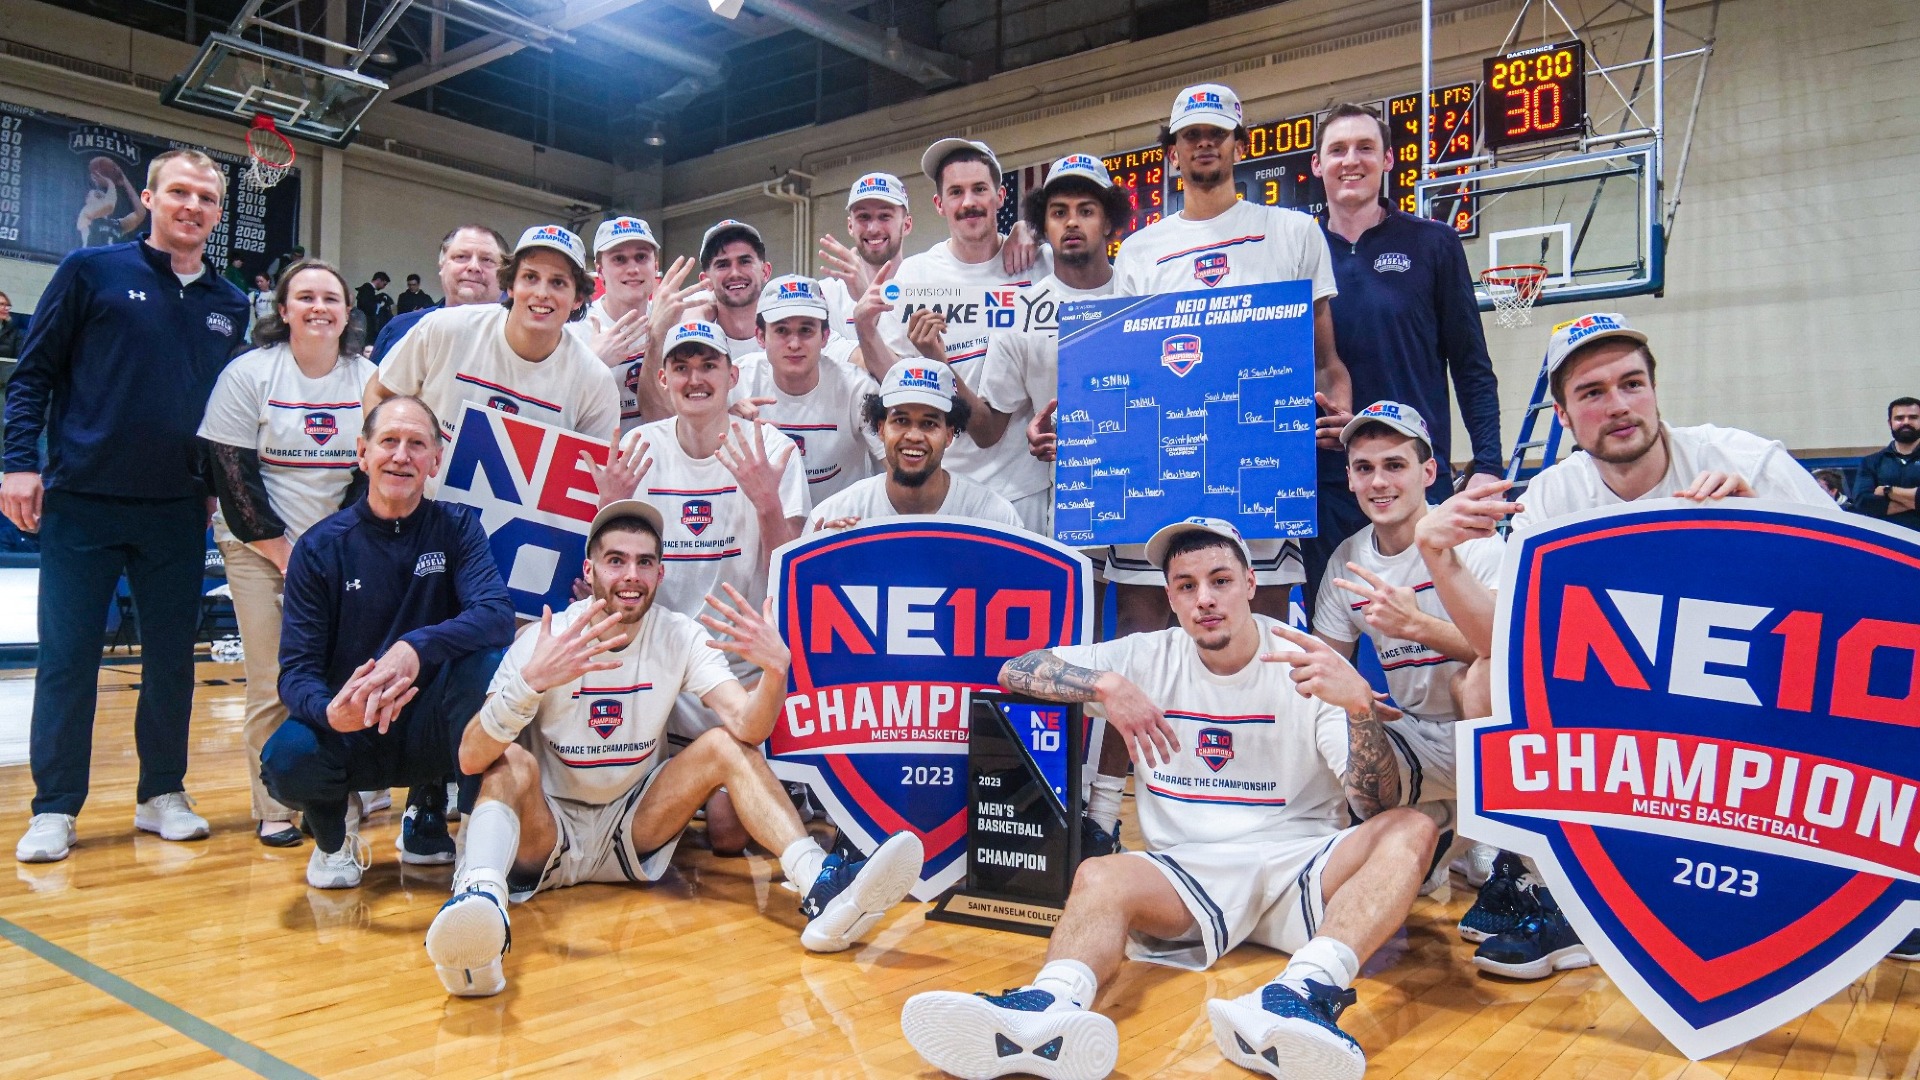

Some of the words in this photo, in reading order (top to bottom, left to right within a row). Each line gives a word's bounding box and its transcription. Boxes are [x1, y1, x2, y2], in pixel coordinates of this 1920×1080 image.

[1506, 44, 1553, 59] DAKTRONICS
[1492, 50, 1572, 90] 20:00
[1188, 92, 1220, 104] NE10
[1392, 97, 1416, 115] PLY
[1444, 86, 1471, 105] PTS
[1505, 82, 1560, 135] 30
[1406, 119, 1418, 135] 4
[1243, 118, 1311, 159] 0:00
[73, 134, 136, 160] ANSELM
[1400, 143, 1418, 161] 10
[1450, 134, 1470, 153] 19
[1063, 155, 1092, 167] NE10
[1126, 153, 1139, 168] FL
[1141, 149, 1163, 165] PTS
[1255, 166, 1286, 181] PERIOD
[1400, 168, 1418, 187] 12
[860, 177, 887, 188] NE10
[237, 191, 267, 206] 2018
[1265, 180, 1278, 205] 3
[236, 202, 267, 218] 2019
[1400, 194, 1417, 213] 15
[235, 225, 267, 241] 2020
[613, 220, 642, 230] NE10
[538, 226, 570, 242] NE10
[234, 237, 266, 254] 2022
[780, 281, 809, 294] NE10
[905, 287, 951, 298] DIVISION
[984, 291, 1016, 307] NE
[1175, 297, 1206, 314] NE10
[1209, 293, 1253, 311] MEN'S
[986, 309, 1015, 328] 10
[1122, 314, 1202, 333] BASKETBALL
[1204, 302, 1308, 327] CHAMPIONSHIP
[1568, 315, 1614, 335] NE10
[679, 322, 711, 334] NE10
[1567, 323, 1621, 346] CHAMPIONS
[945, 339, 974, 353] MBRACE
[1168, 342, 1197, 351] NE10
[904, 367, 938, 382] NE10
[1268, 365, 1293, 376] Anselm
[898, 379, 941, 391] CHAMPIONS
[1101, 373, 1130, 387] SNHU
[1129, 395, 1156, 408] SNHU
[1244, 411, 1263, 424] Pace
[1363, 404, 1401, 417] NE10
[1097, 419, 1121, 434] FPU
[265, 446, 302, 457] EMBRACE
[304, 449, 318, 457] THE
[1097, 511, 1121, 521] SCSU
[680, 540, 694, 548] THE
[1070, 531, 1095, 541] SCSU
[810, 584, 1051, 657] NE10
[1552, 584, 1920, 729] NE10
[593, 705, 619, 715] NE10
[784, 684, 1002, 739] CHAMPI
[1030, 710, 1061, 730] NE
[871, 728, 909, 741] MEN'S
[1031, 730, 1061, 752] 10
[1202, 733, 1231, 746] NE10
[549, 740, 585, 755] EMBRACE
[587, 745, 601, 755] THE
[602, 738, 657, 754] CHAMPIONSHIP
[900, 765, 955, 787] 2023
[978, 775, 1002, 788] 2023
[1153, 770, 1192, 787] EMBRACE
[1194, 777, 1211, 788] THE
[1212, 778, 1277, 791] CHAMPIONSHIP
[1508, 733, 1920, 853] CHAMPION
[977, 801, 1015, 819] MEN'S
[977, 817, 1045, 839] BASKETBALL
[1631, 797, 1692, 821] MEN'S
[1694, 804, 1821, 845] BASKETBALL
[977, 847, 1047, 872] CHAMPION
[1672, 857, 1760, 898] 2023
[968, 901, 992, 913] SAINT
[992, 904, 1026, 918] ANSELM
